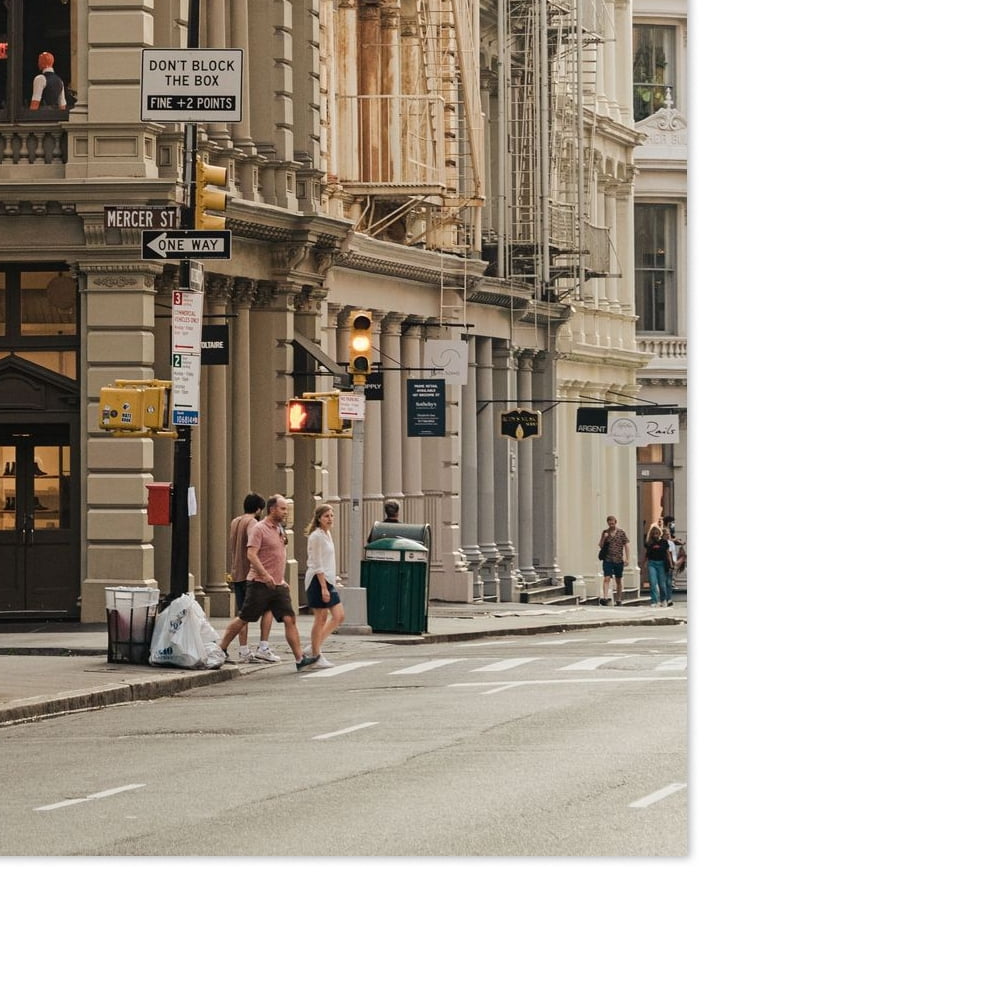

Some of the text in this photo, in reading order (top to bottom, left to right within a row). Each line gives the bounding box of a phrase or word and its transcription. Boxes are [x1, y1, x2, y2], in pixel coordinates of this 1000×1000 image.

[149, 60, 235, 71] DON'T BLOCK
[165, 75, 219, 86] THE BOX
[150, 97, 232, 109] FINE +2 POINTS
[107, 210, 175, 228] MERCER ST
[158, 239, 219, 251] ONE WAY
[175, 292, 181, 305] 3
[174, 354, 181, 367] 2
[578, 425, 607, 433] ARGENT
